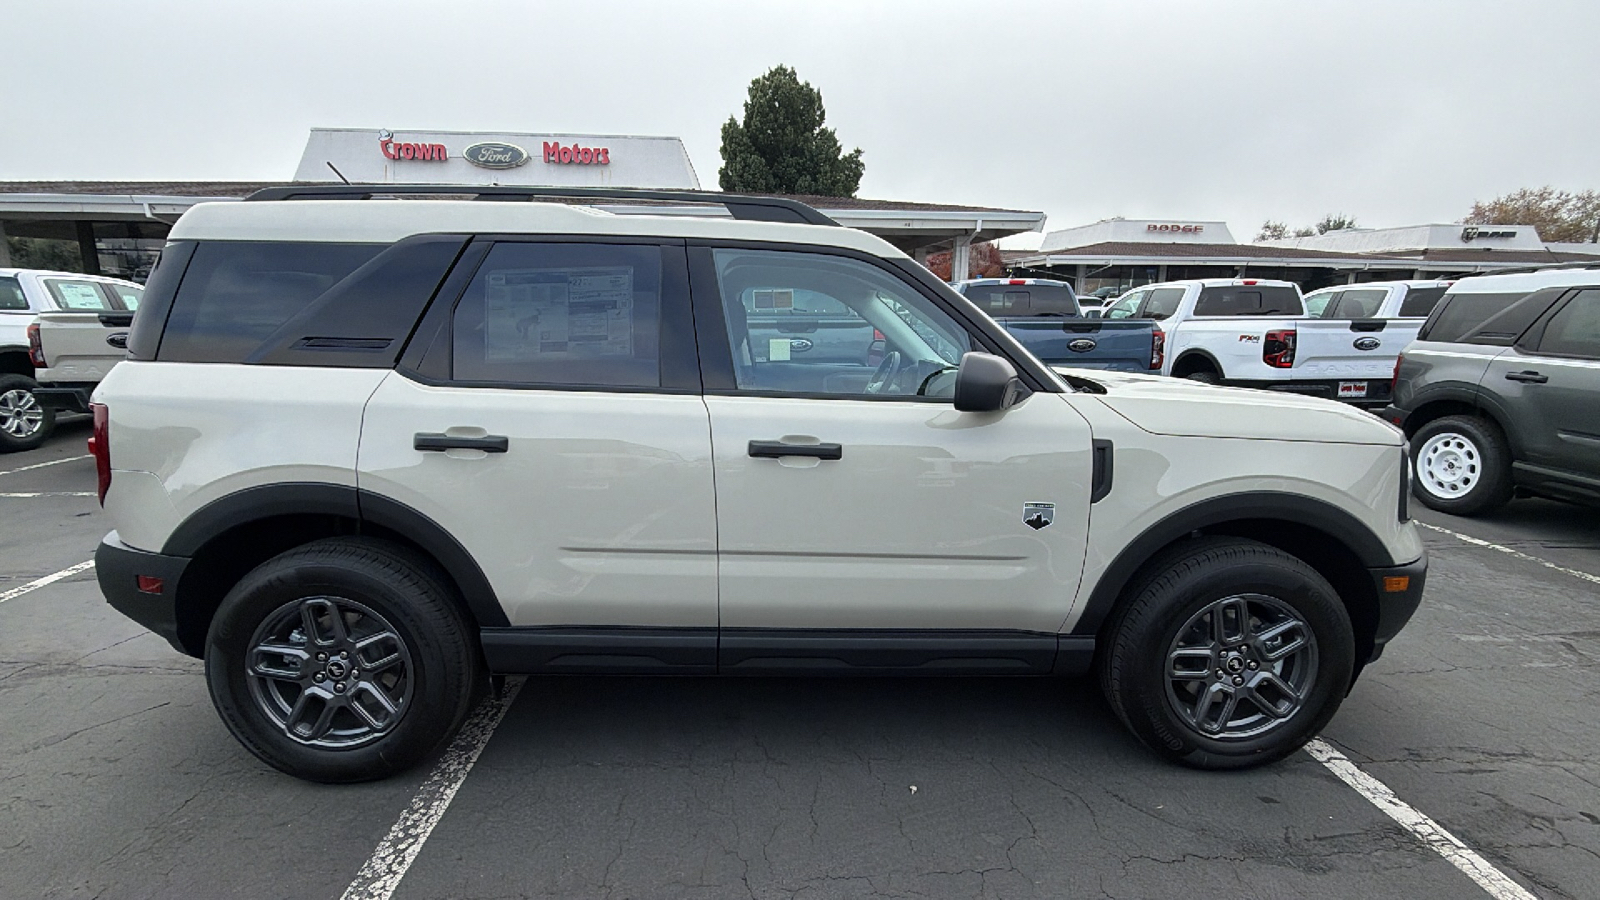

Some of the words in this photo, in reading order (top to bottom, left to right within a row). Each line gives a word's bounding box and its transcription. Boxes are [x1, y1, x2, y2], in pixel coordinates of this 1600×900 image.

[380, 138, 448, 161] Crown
[478, 146, 512, 162] Ford
[542, 141, 610, 164] Motors
[1147, 224, 1204, 233] DODGE
